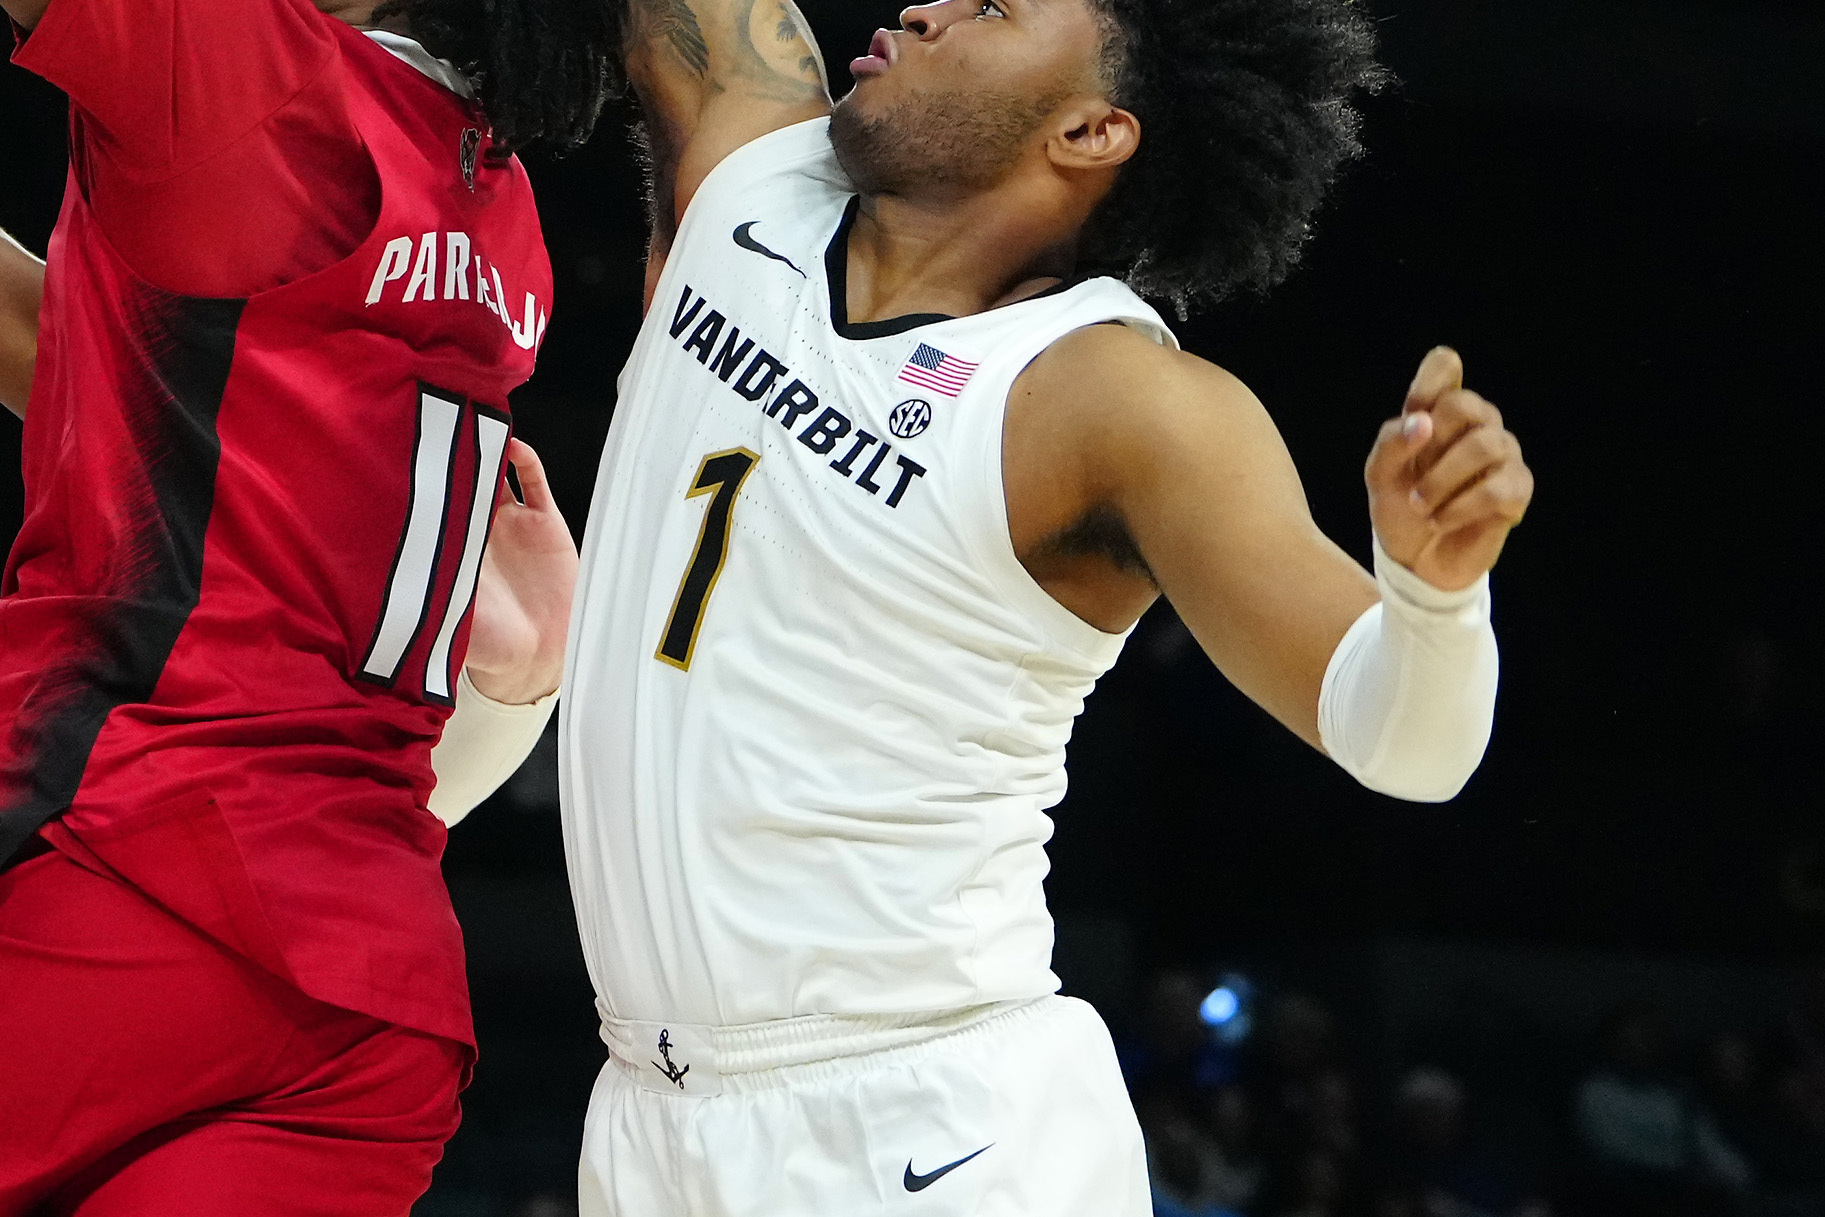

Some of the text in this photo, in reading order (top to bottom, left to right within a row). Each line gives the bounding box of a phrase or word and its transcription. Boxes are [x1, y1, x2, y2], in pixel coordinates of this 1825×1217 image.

[889, 399, 932, 438] SEC
[354, 381, 513, 707] 11
[654, 446, 761, 672] 1
